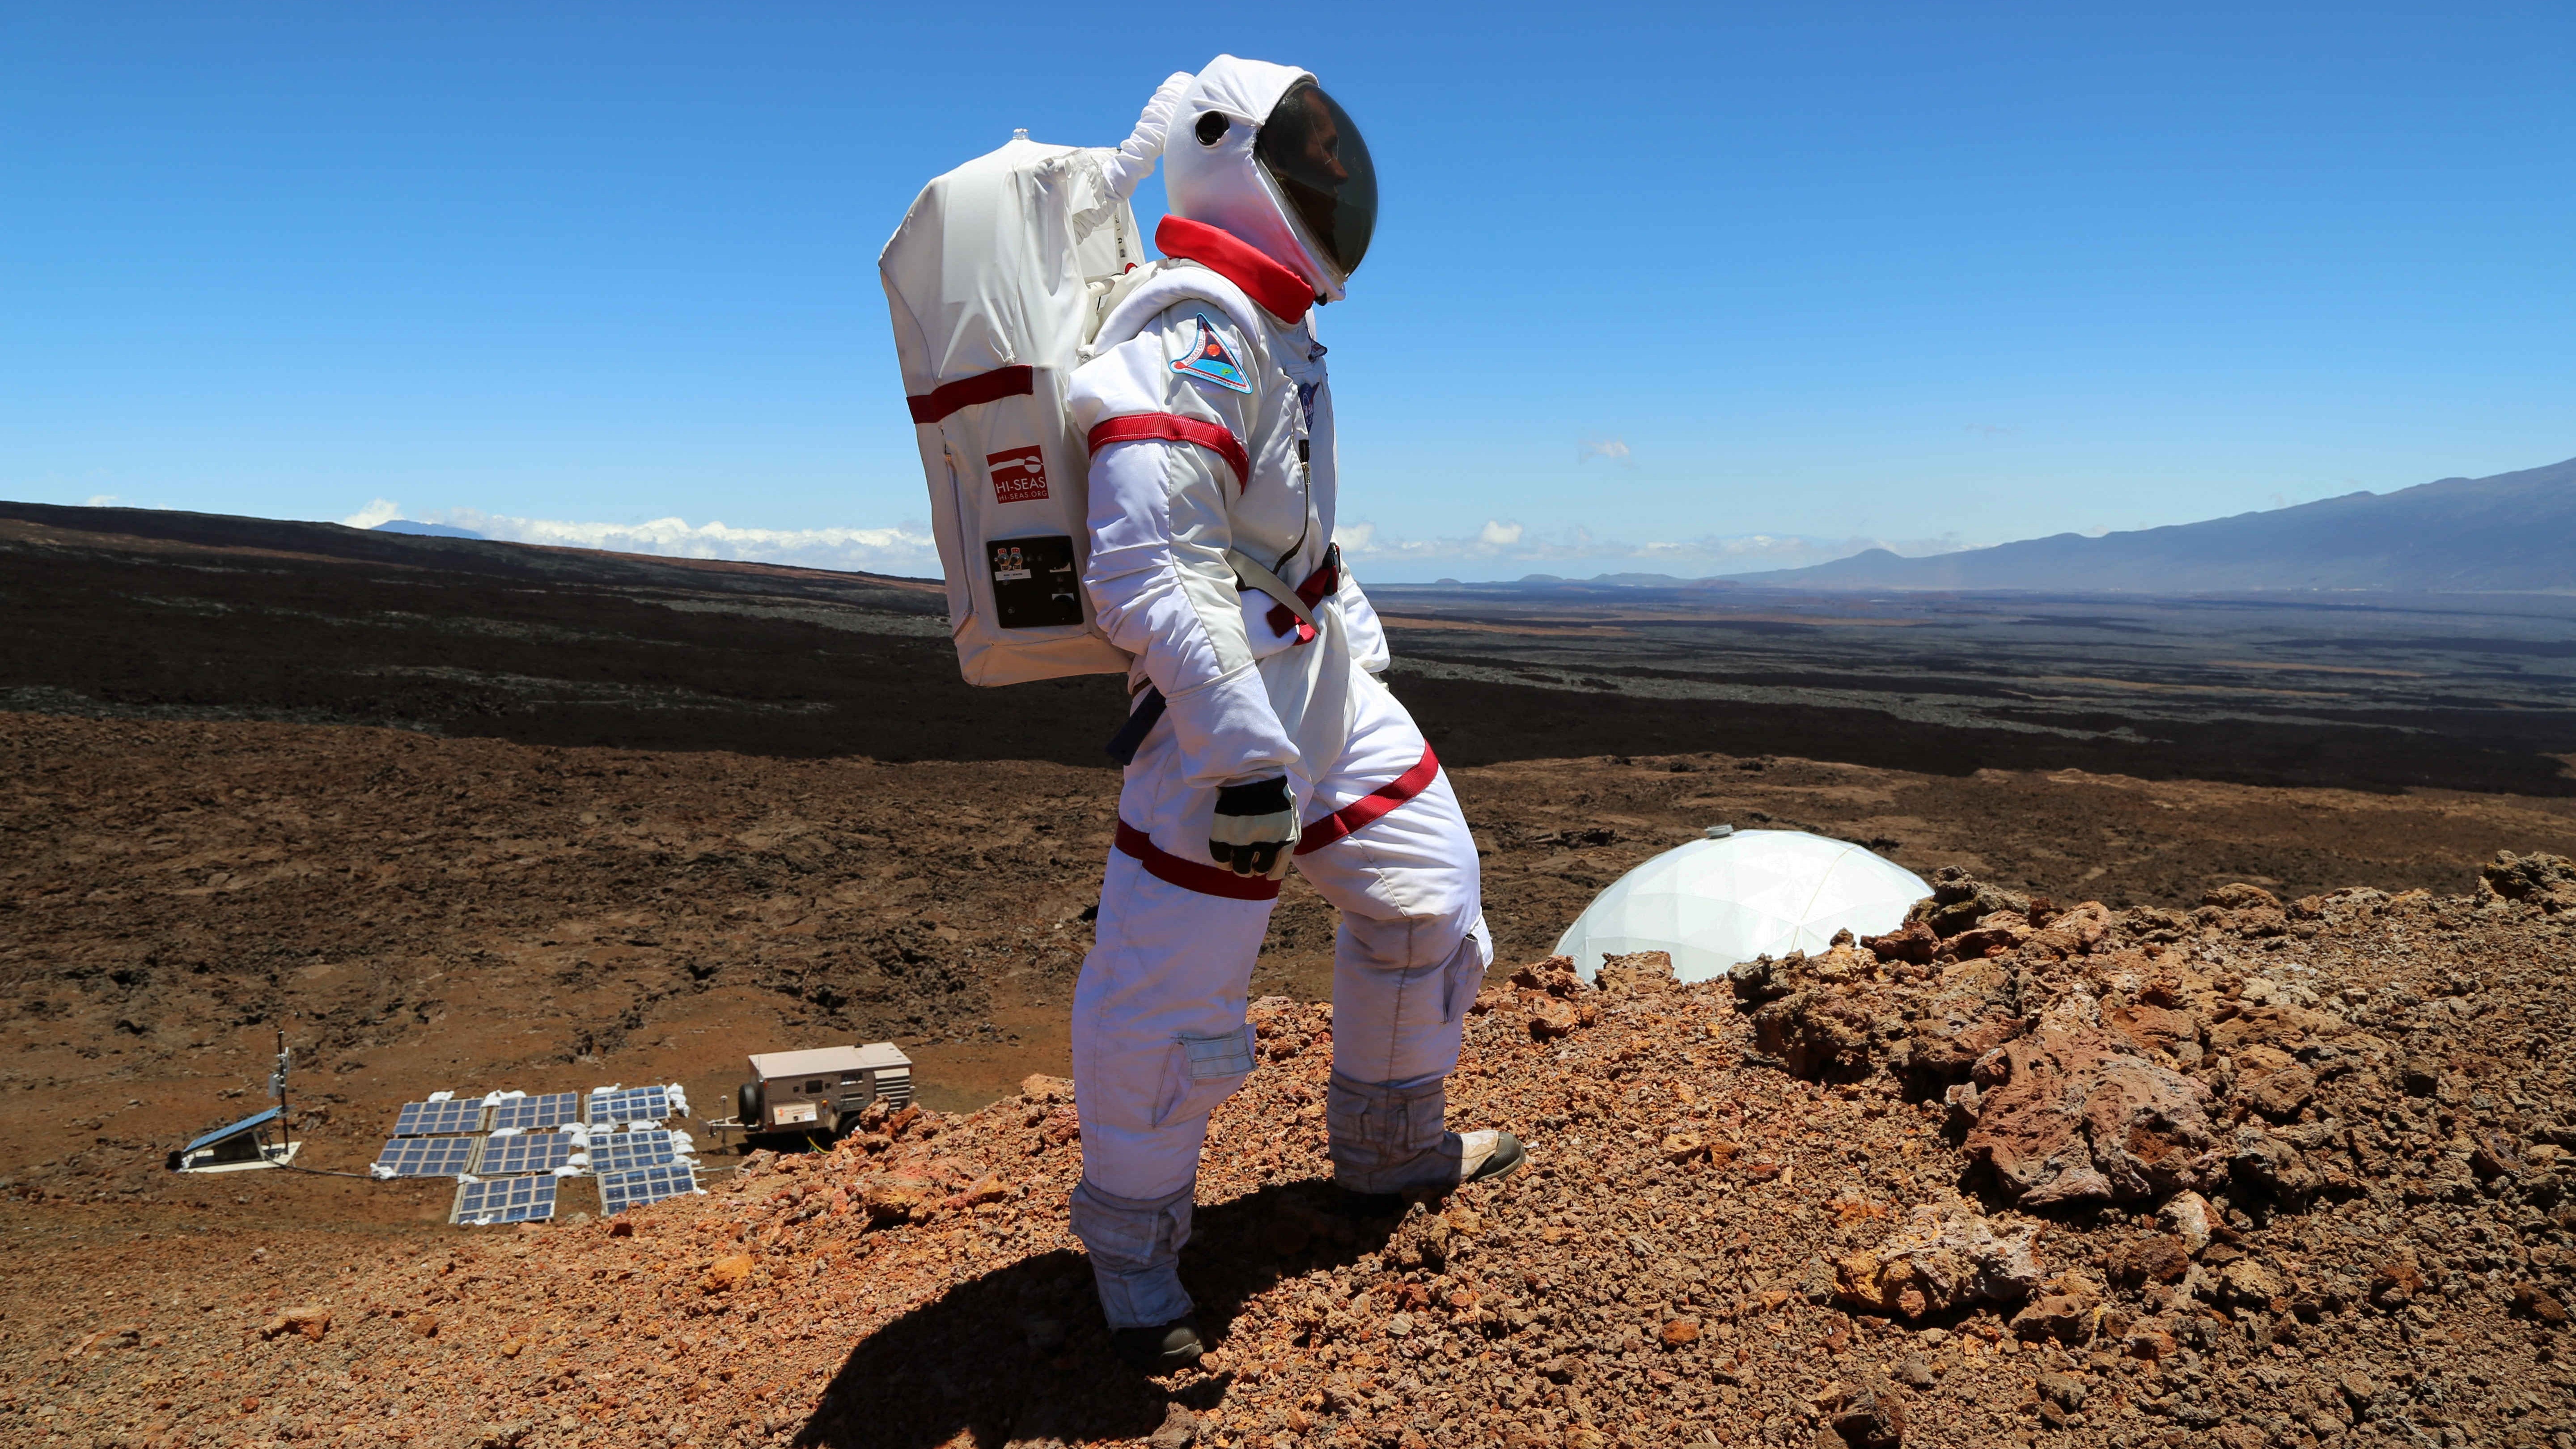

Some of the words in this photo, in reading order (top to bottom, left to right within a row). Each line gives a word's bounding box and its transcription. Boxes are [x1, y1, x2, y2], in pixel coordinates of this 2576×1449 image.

[1184, 349, 1199, 362] HI-SEAS
[996, 476, 1046, 493] HI-SEAS
[998, 490, 1047, 501] HI-SEAS.ORG
